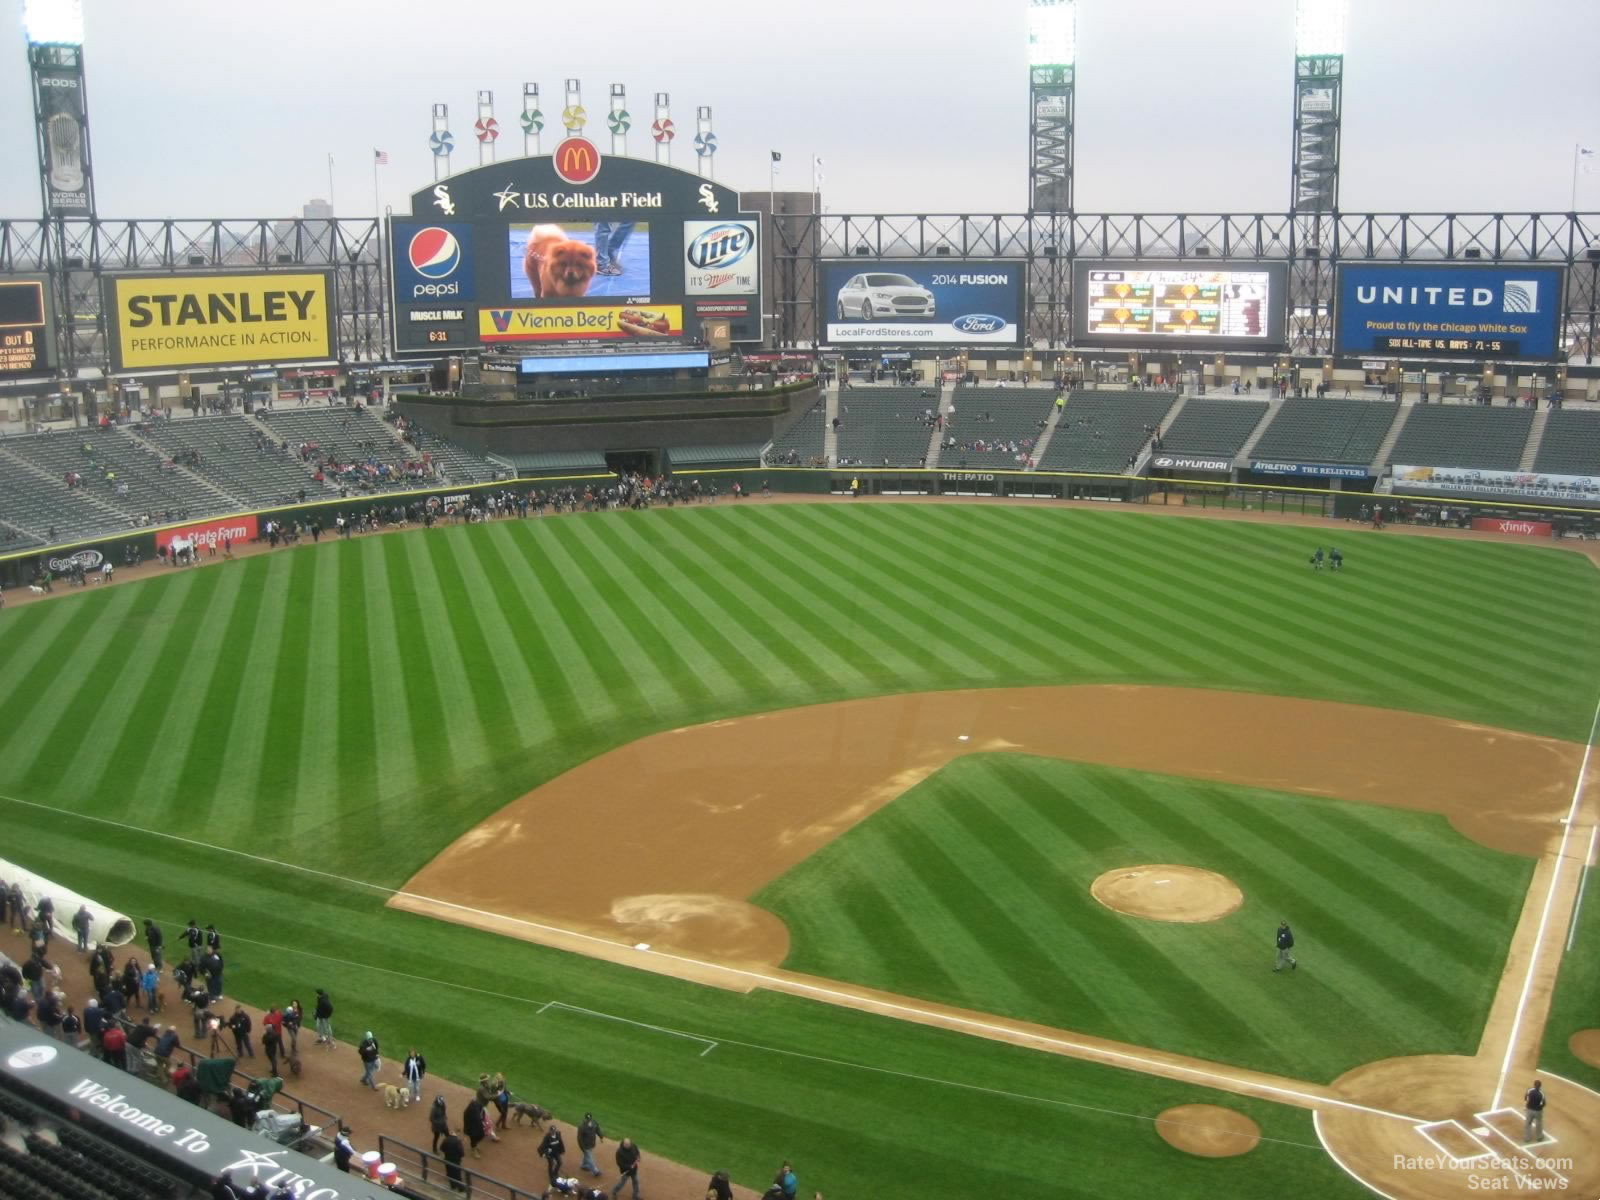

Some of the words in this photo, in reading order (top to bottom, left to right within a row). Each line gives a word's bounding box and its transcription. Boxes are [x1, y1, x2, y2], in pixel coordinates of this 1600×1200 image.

[42, 78, 77, 88] 2005
[524, 193, 549, 208] U.S.
[552, 192, 618, 208] Cellular
[621, 192, 662, 208] Field
[699, 232, 745, 268] Lite
[703, 273, 736, 289] Miller
[736, 276, 751, 286] TIME
[932, 274, 958, 285] 2014
[959, 274, 1008, 285] FUSION
[414, 281, 459, 298] pepsi
[1357, 286, 1494, 306] UNITED
[128, 290, 317, 328] STANLEY
[410, 311, 442, 321] MUSCLE
[442, 310, 463, 320] MILK
[518, 312, 574, 328] Vienna
[577, 311, 614, 328] Beef
[962, 316, 996, 332] Ford
[1366, 320, 1394, 330] Proud
[1396, 322, 1406, 330] to
[1408, 322, 1420, 332] fly
[1423, 322, 1439, 332] the
[1440, 323, 1476, 334] Chicago
[1478, 324, 1508, 333] White
[1510, 324, 1528, 334] Sox
[836, 328, 934, 337] LocalFordStores.com
[5, 335, 22, 346] OUT
[132, 334, 236, 351] PERFORMANCE
[241, 333, 255, 345] IN
[260, 331, 312, 344] ACTION
[1176, 460, 1228, 470] HYUNDAI
[1254, 462, 1297, 472] ATHLETICO
[944, 472, 962, 480] THE
[1500, 522, 1534, 534] xfinity
[69, 1078, 176, 1137] Welcome
[174, 1127, 210, 1152] To
